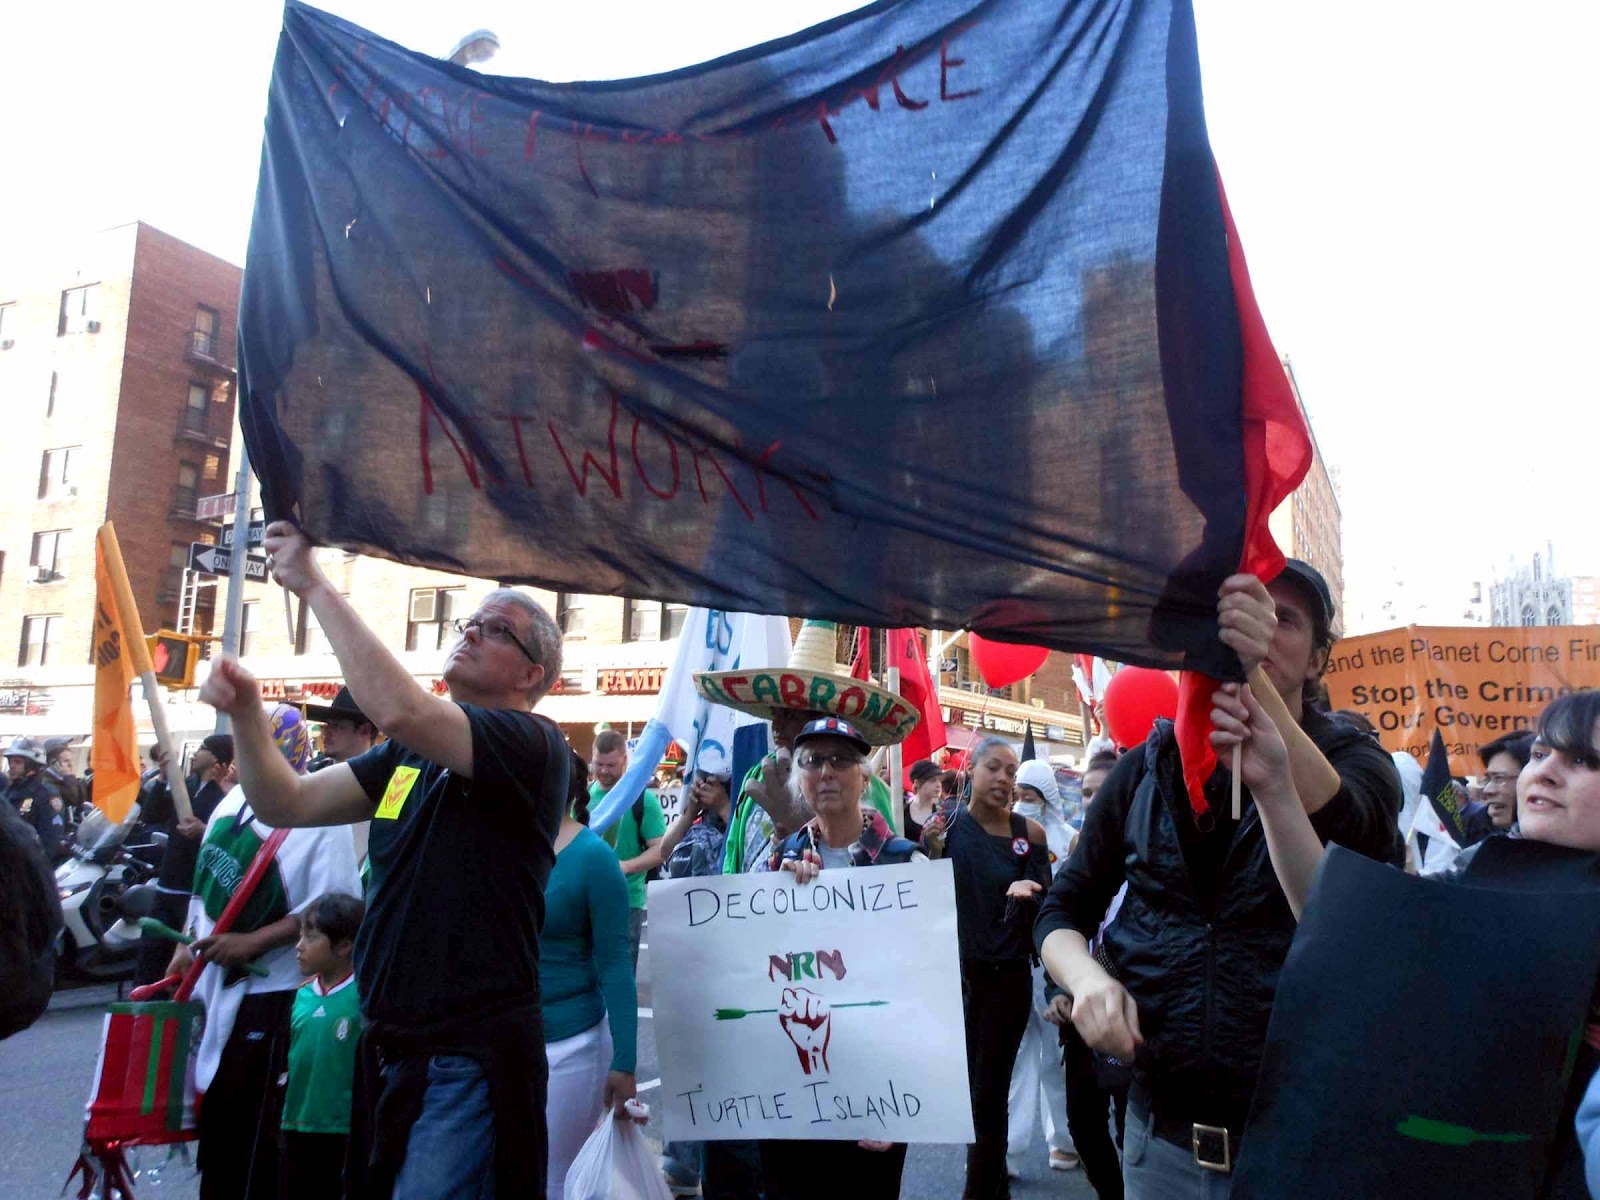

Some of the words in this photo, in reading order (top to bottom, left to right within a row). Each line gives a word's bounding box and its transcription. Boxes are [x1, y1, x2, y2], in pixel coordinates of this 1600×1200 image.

[1327, 649, 1364, 674] and
[1370, 645, 1405, 666] the
[1411, 638, 1480, 662] Planet
[1488, 640, 1559, 663] Come
[1352, 685, 1415, 706] Stop
[1424, 678, 1468, 700] the
[1479, 681, 1592, 702] Crim
[1380, 710, 1424, 731] Our
[1434, 705, 1538, 731] Govern
[684, 878, 919, 927] DECOLONIZE
[768, 949, 847, 982] NRN
[677, 1087, 793, 1128] TURTLE
[802, 1079, 921, 1128] ISLAND
